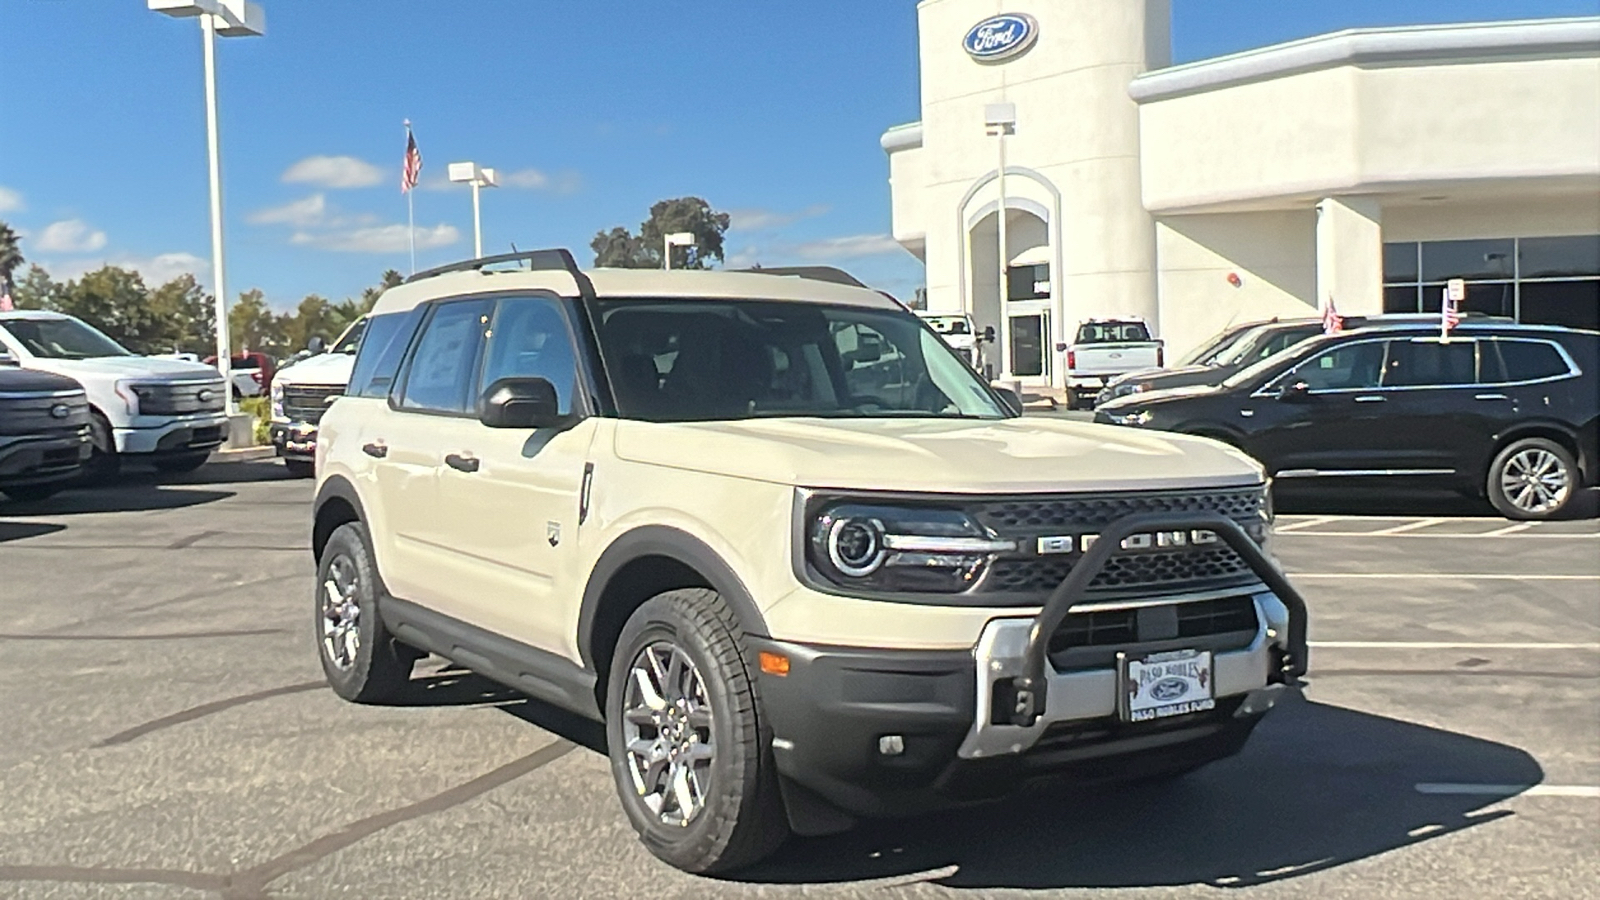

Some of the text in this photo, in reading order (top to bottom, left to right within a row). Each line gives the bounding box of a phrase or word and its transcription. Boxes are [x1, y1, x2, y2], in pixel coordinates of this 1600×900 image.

[974, 21, 1016, 51] Ford
[1037, 529, 1218, 555] BONC
[1140, 666, 1163, 687] PASO
